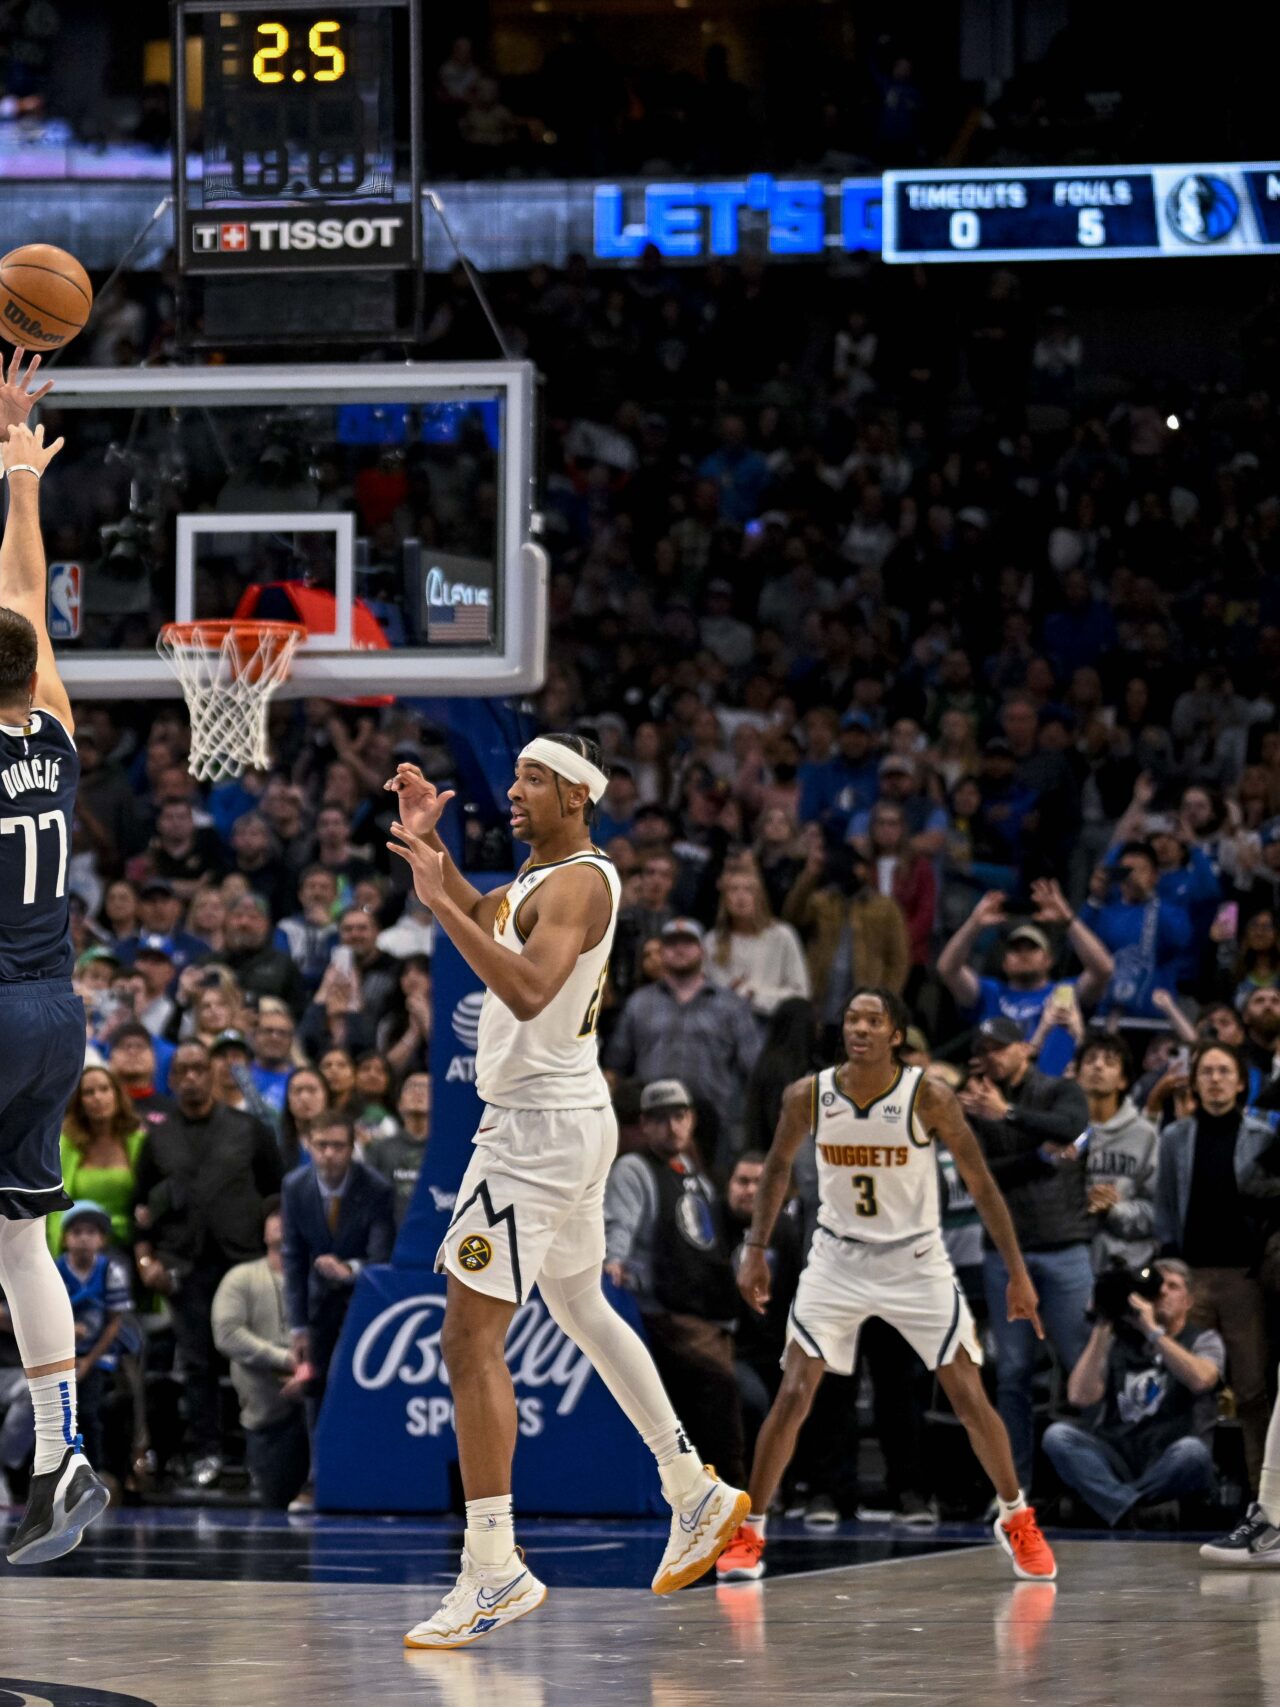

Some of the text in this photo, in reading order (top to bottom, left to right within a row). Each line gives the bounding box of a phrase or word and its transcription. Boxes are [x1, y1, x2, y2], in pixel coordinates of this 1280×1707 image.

[253, 21, 345, 83] 2.5
[906, 183, 1027, 210] TIMEOUTS
[1054, 180, 1131, 206] FOULS
[250, 218, 403, 250] TISSOT
[594, 173, 882, 257] LET'S G
[950, 210, 980, 249] 0
[1078, 208, 1105, 246] 5
[4, 299, 65, 343] Wilson
[0, 809, 68, 905] 77
[819, 1144, 908, 1167] NUGGETS
[852, 1174, 878, 1217] 3
[352, 1294, 593, 1415] Blly
